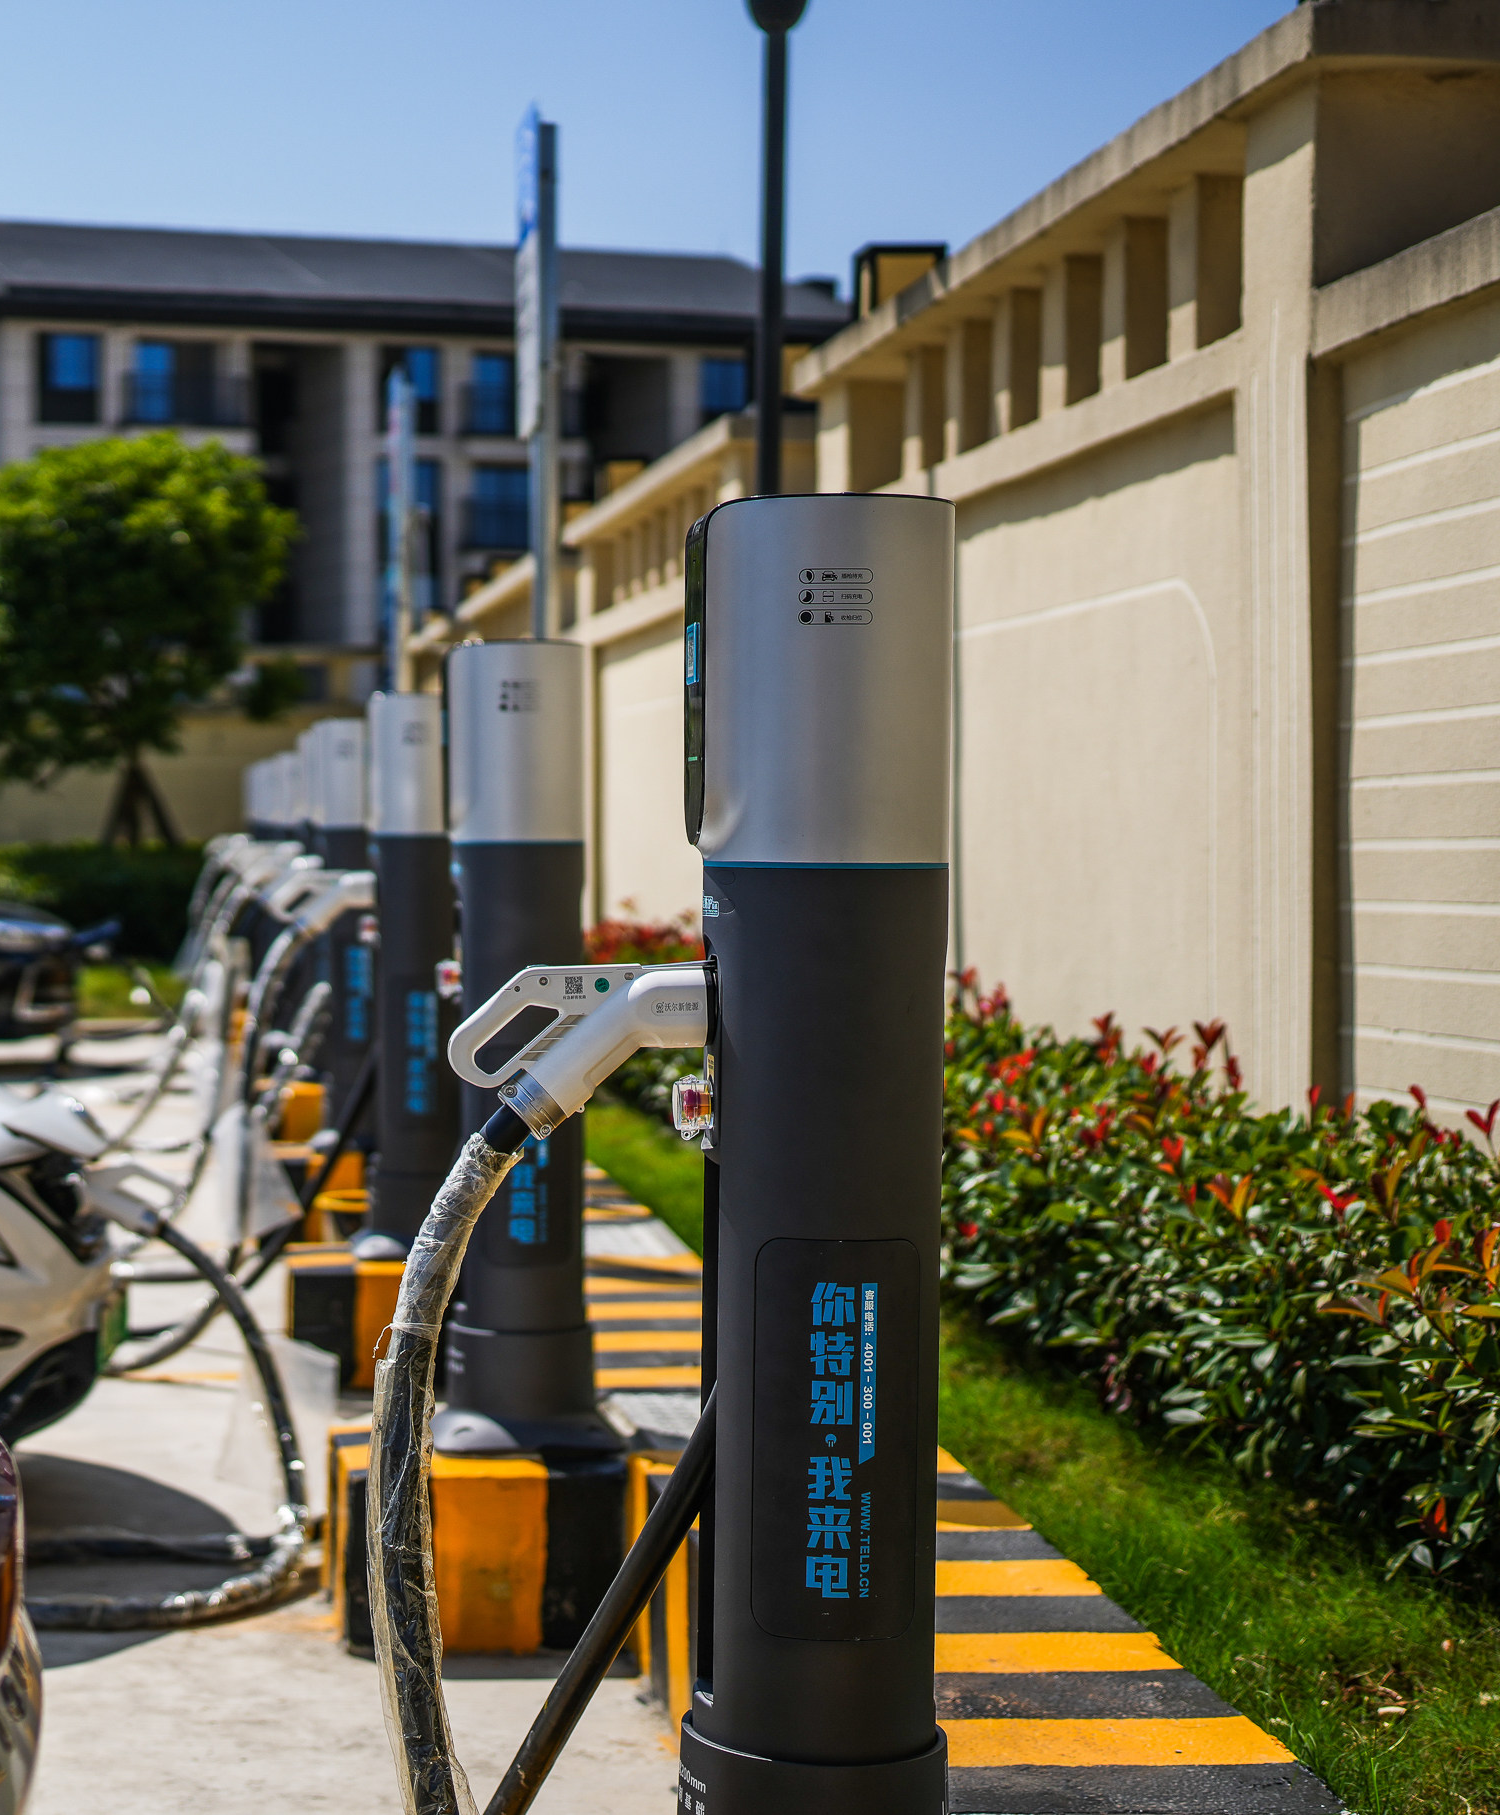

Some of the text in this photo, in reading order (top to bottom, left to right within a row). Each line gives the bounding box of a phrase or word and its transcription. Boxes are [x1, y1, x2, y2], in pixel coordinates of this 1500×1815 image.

[664, 1001, 699, 1012] 沃尔新能源
[859, 1491, 871, 1599] WWW.TELD.CN
